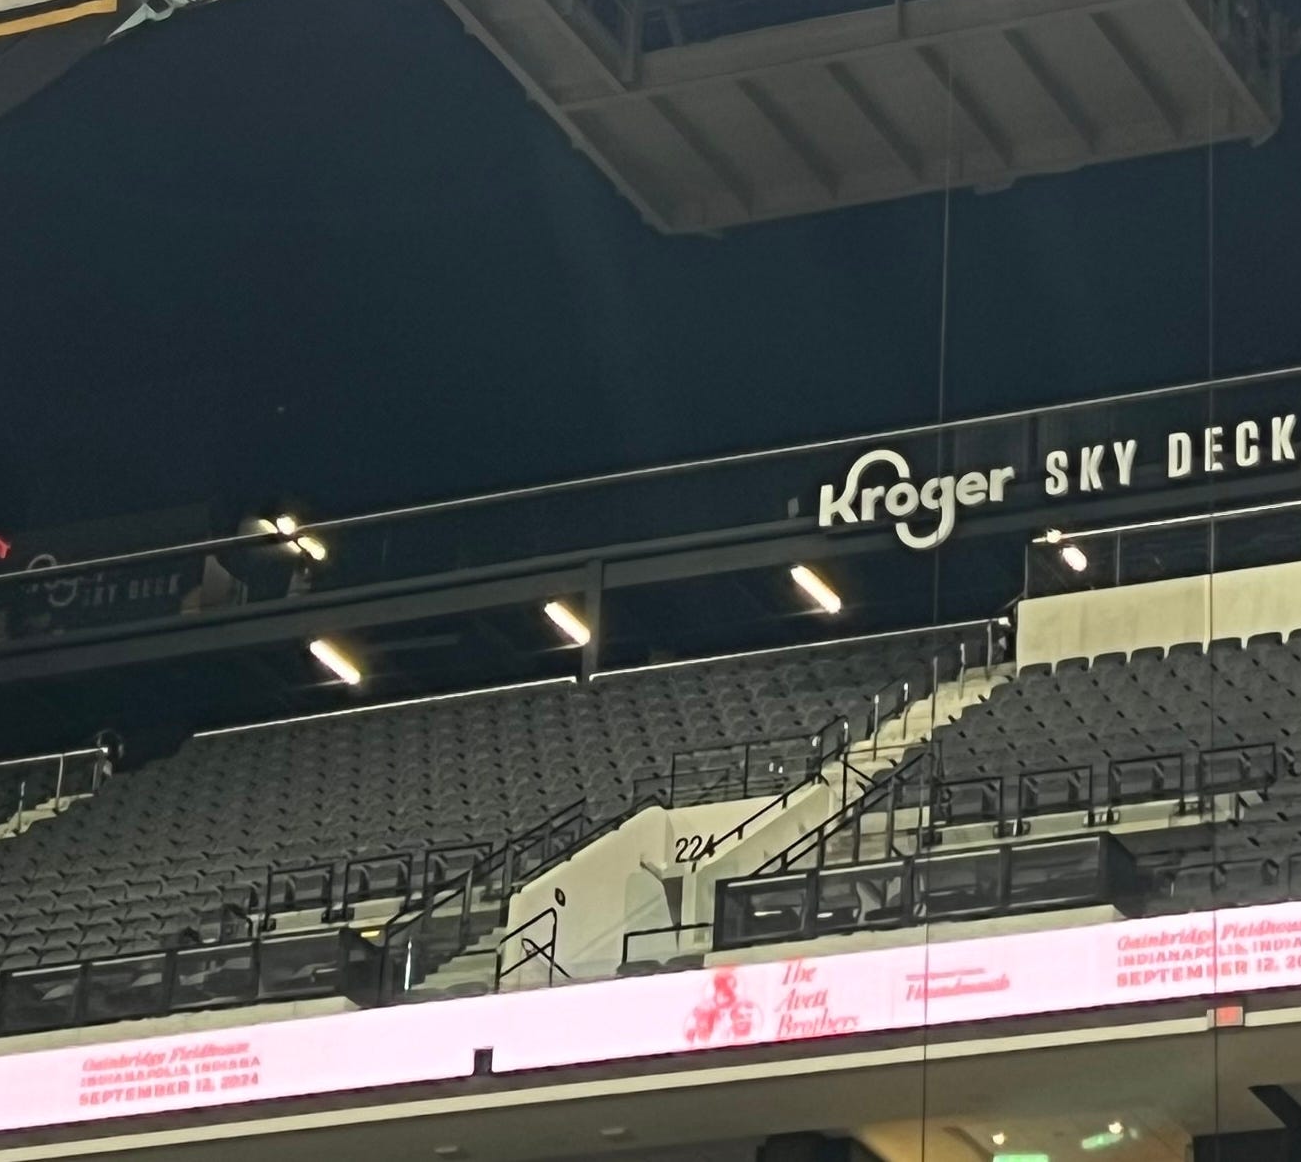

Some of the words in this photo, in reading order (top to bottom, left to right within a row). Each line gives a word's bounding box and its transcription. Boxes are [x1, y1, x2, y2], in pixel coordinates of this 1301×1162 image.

[818, 449, 1015, 549] Kroger
[1045, 439, 1137, 496] SKY
[1168, 413, 1297, 479] DECK
[782, 956, 817, 986] The
[1116, 960, 1248, 988] SEPTEMBER
